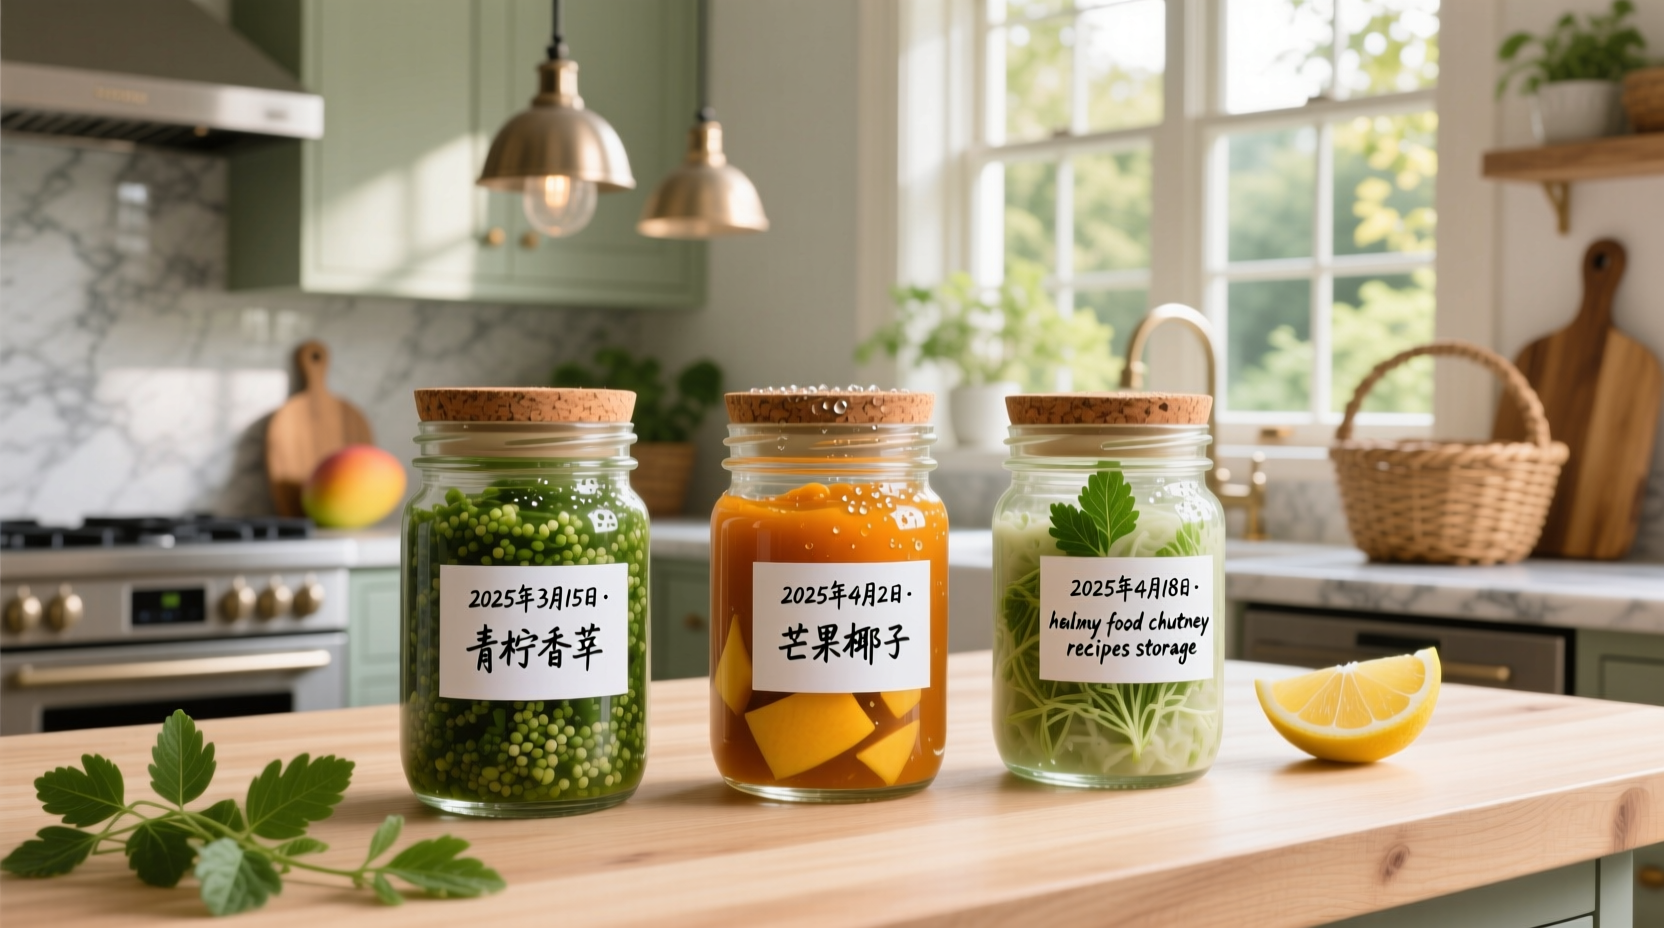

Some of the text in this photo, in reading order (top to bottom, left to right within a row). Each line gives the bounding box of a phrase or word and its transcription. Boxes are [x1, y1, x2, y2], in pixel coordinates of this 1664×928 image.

[1106, 611, 1145, 637] food
[1149, 610, 1210, 636] chutney
[778, 622, 911, 666] 芒果椰子
[1066, 639, 1198, 665] recipes storage
